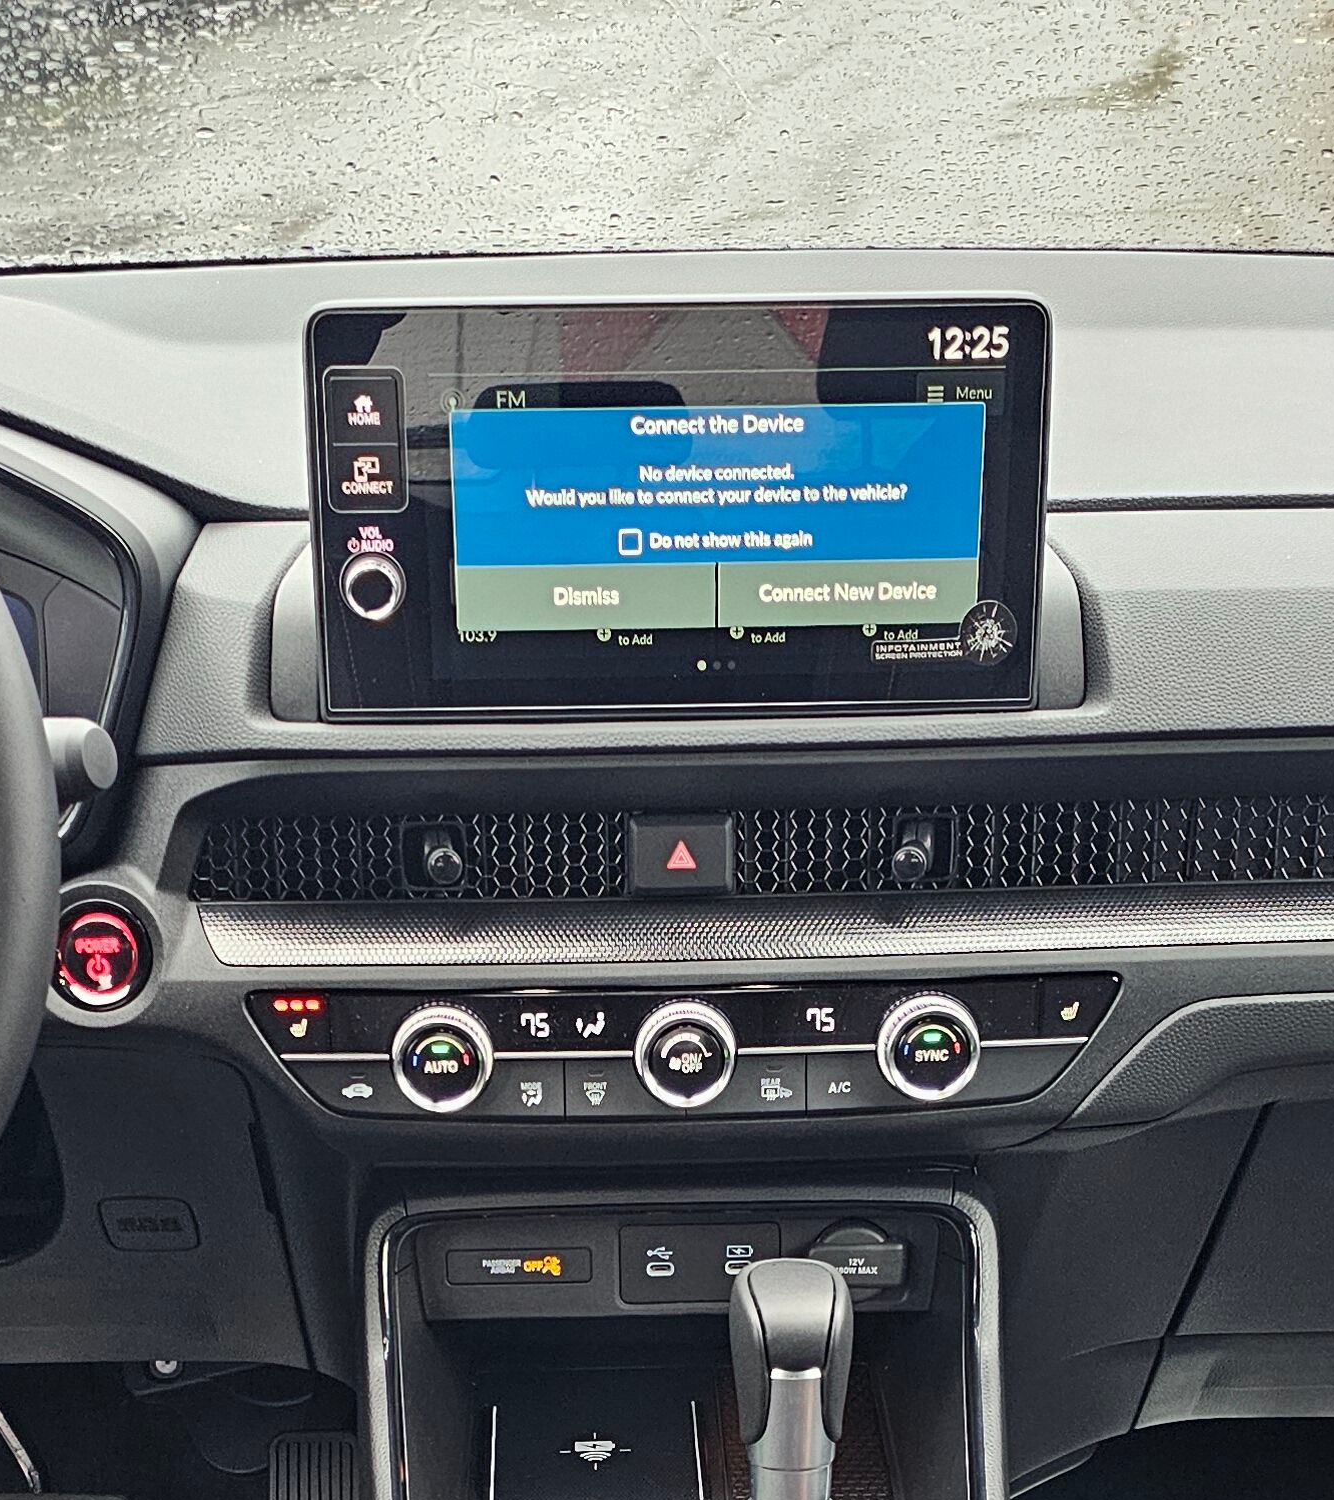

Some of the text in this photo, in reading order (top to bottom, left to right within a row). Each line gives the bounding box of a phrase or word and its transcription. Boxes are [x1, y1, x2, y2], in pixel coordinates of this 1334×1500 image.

[928, 325, 1009, 360] 12:25
[496, 390, 526, 408] FM
[955, 386, 993, 400] Menu
[347, 412, 381, 426] HOME
[630, 413, 805, 435] Connect the Device
[639, 463, 795, 482] No device connected.
[341, 480, 394, 495] CONNECT
[524, 483, 908, 508] Would you like to connect your device to the vehicle?
[358, 526, 383, 540] VOL
[649, 530, 813, 550] Do not show this again
[361, 539, 394, 552] AUDIO
[553, 586, 620, 606] Dismiss
[759, 581, 937, 602] Connect New Device
[458, 630, 497, 643] 103.9
[618, 634, 653, 646] to Add
[751, 632, 786, 644] to Add
[884, 629, 918, 641] to Add
[875, 641, 962, 653] INFOTAINMENT
[520, 1007, 835, 1038] 75 75
[915, 1050, 949, 1062] SYNC
[424, 1060, 459, 1074] AUTO
[828, 1082, 851, 1094] A/C
[523, 1260, 544, 1273] OFF
[848, 1257, 865, 1267] 12V
[857, 1266, 878, 1275] MAX
